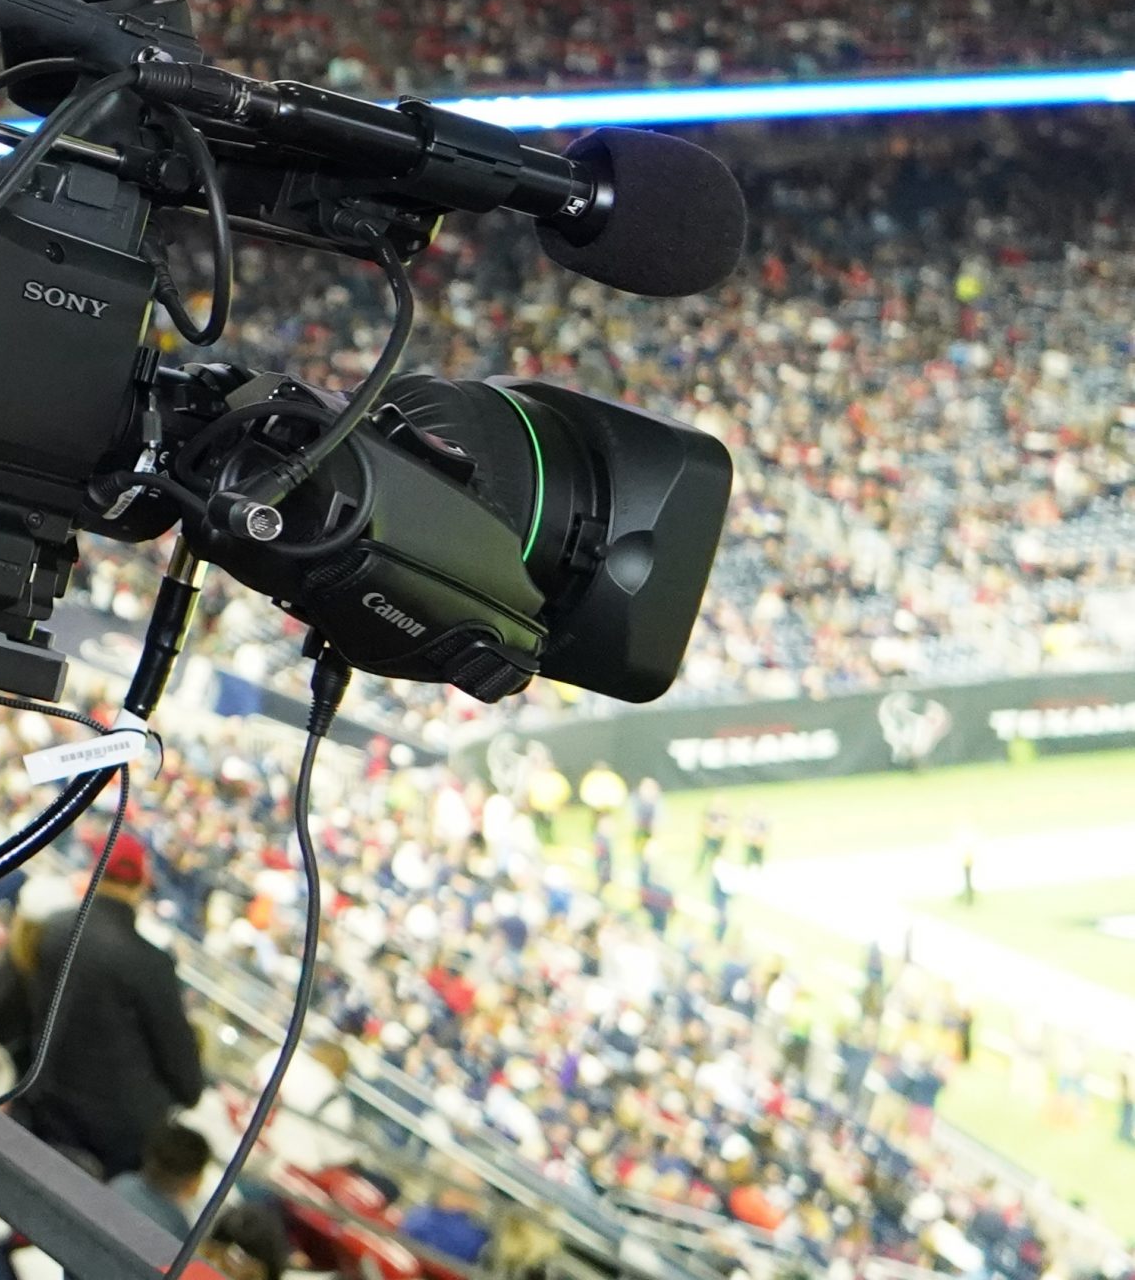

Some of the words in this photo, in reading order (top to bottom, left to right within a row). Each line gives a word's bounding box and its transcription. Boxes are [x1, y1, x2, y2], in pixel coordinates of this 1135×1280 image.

[23, 281, 110, 318] SONY
[361, 592, 427, 638] Canon
[666, 728, 841, 772] TEXANS
